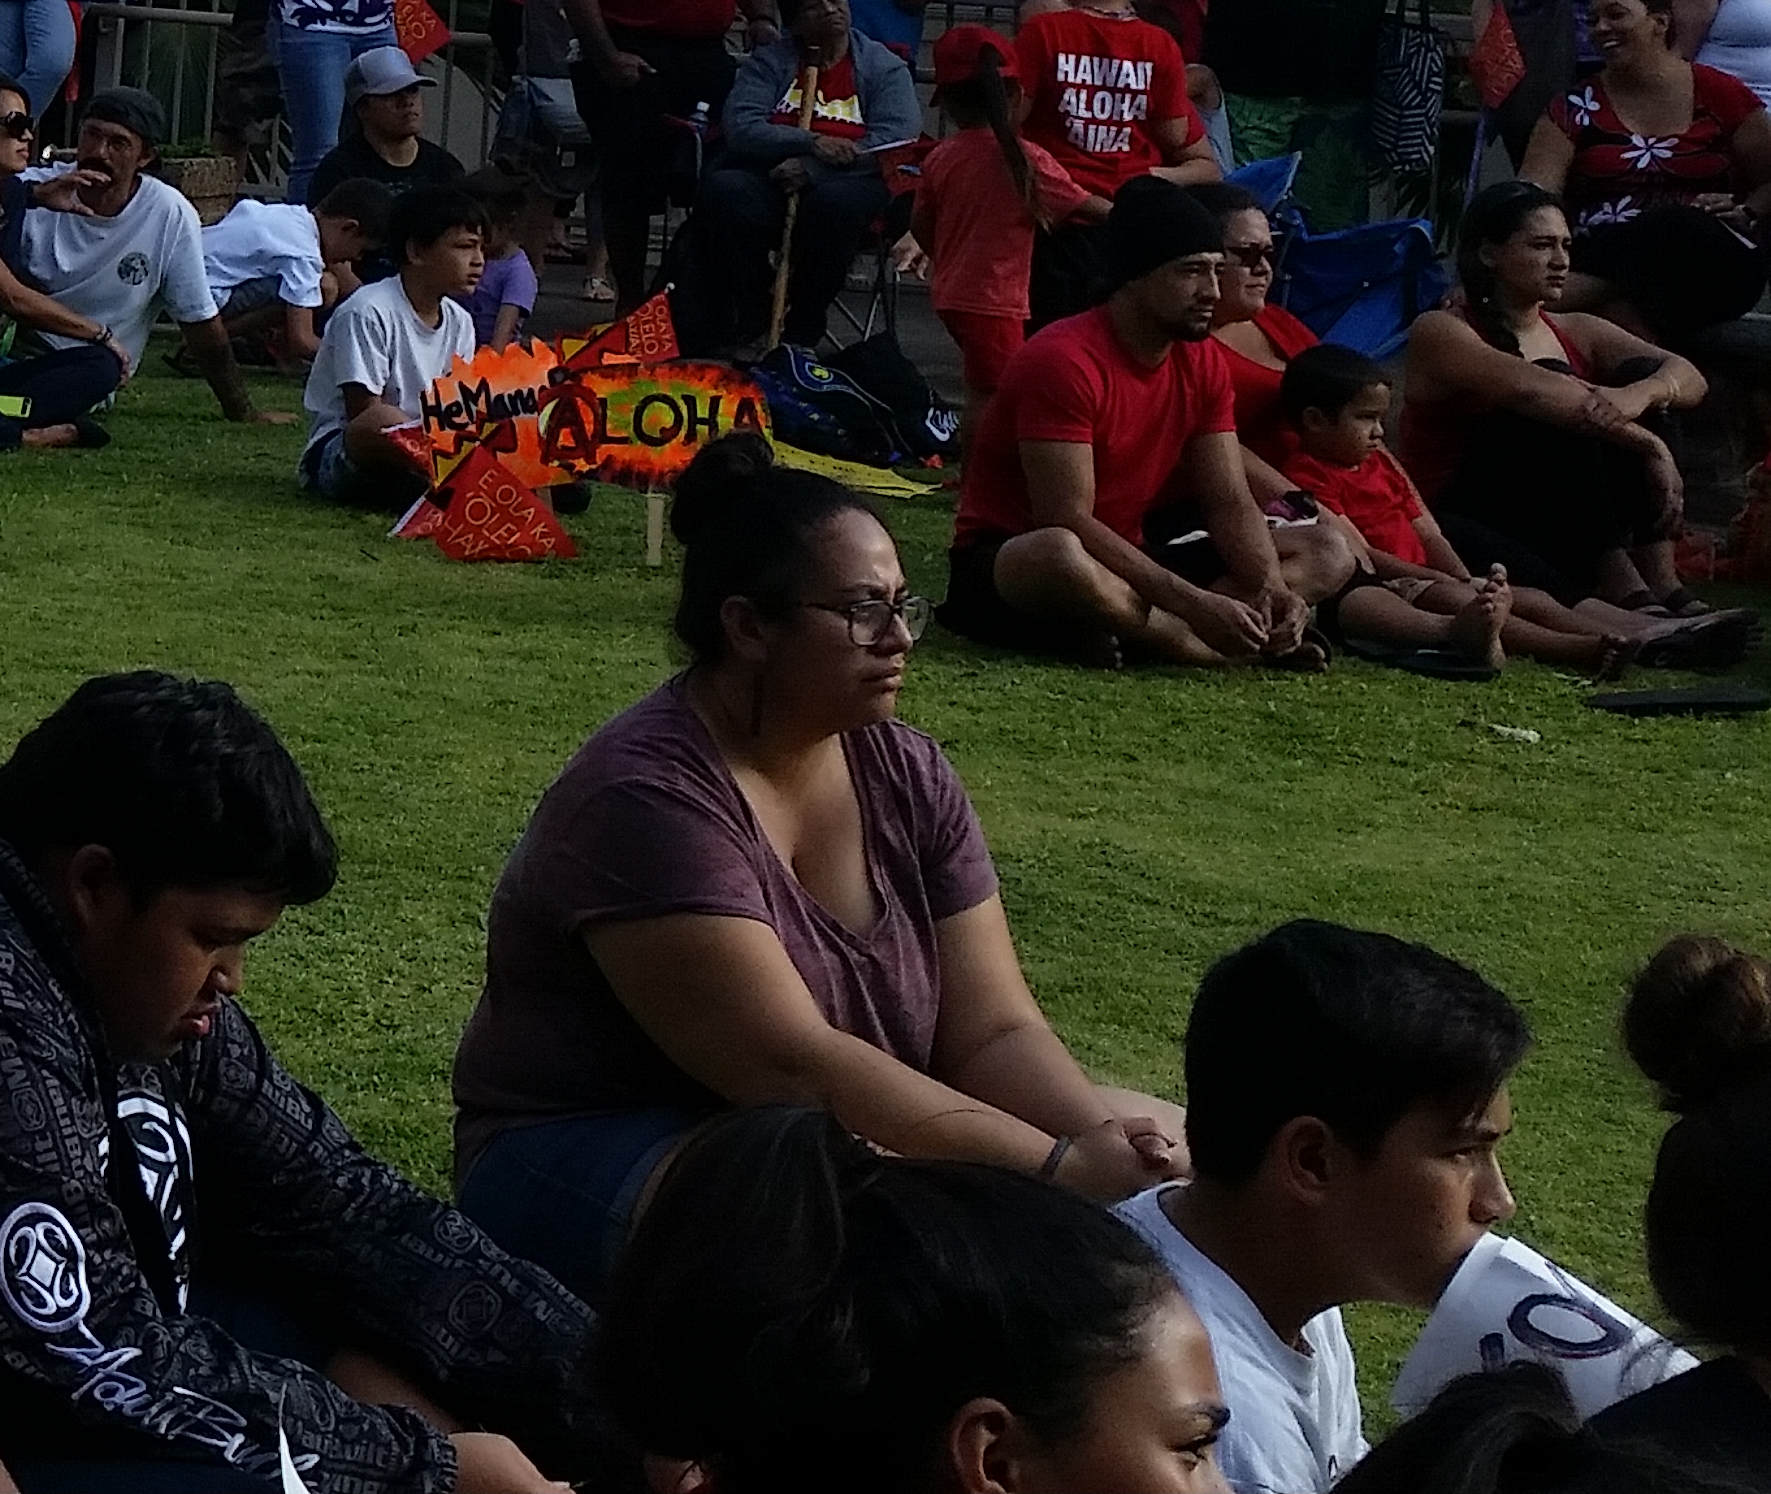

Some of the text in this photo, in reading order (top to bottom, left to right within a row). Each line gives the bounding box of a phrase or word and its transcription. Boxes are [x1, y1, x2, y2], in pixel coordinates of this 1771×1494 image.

[1058, 87, 1148, 122] ALOHA
[540, 384, 763, 465] ALOHA
[478, 468, 557, 554] E OLA KA
